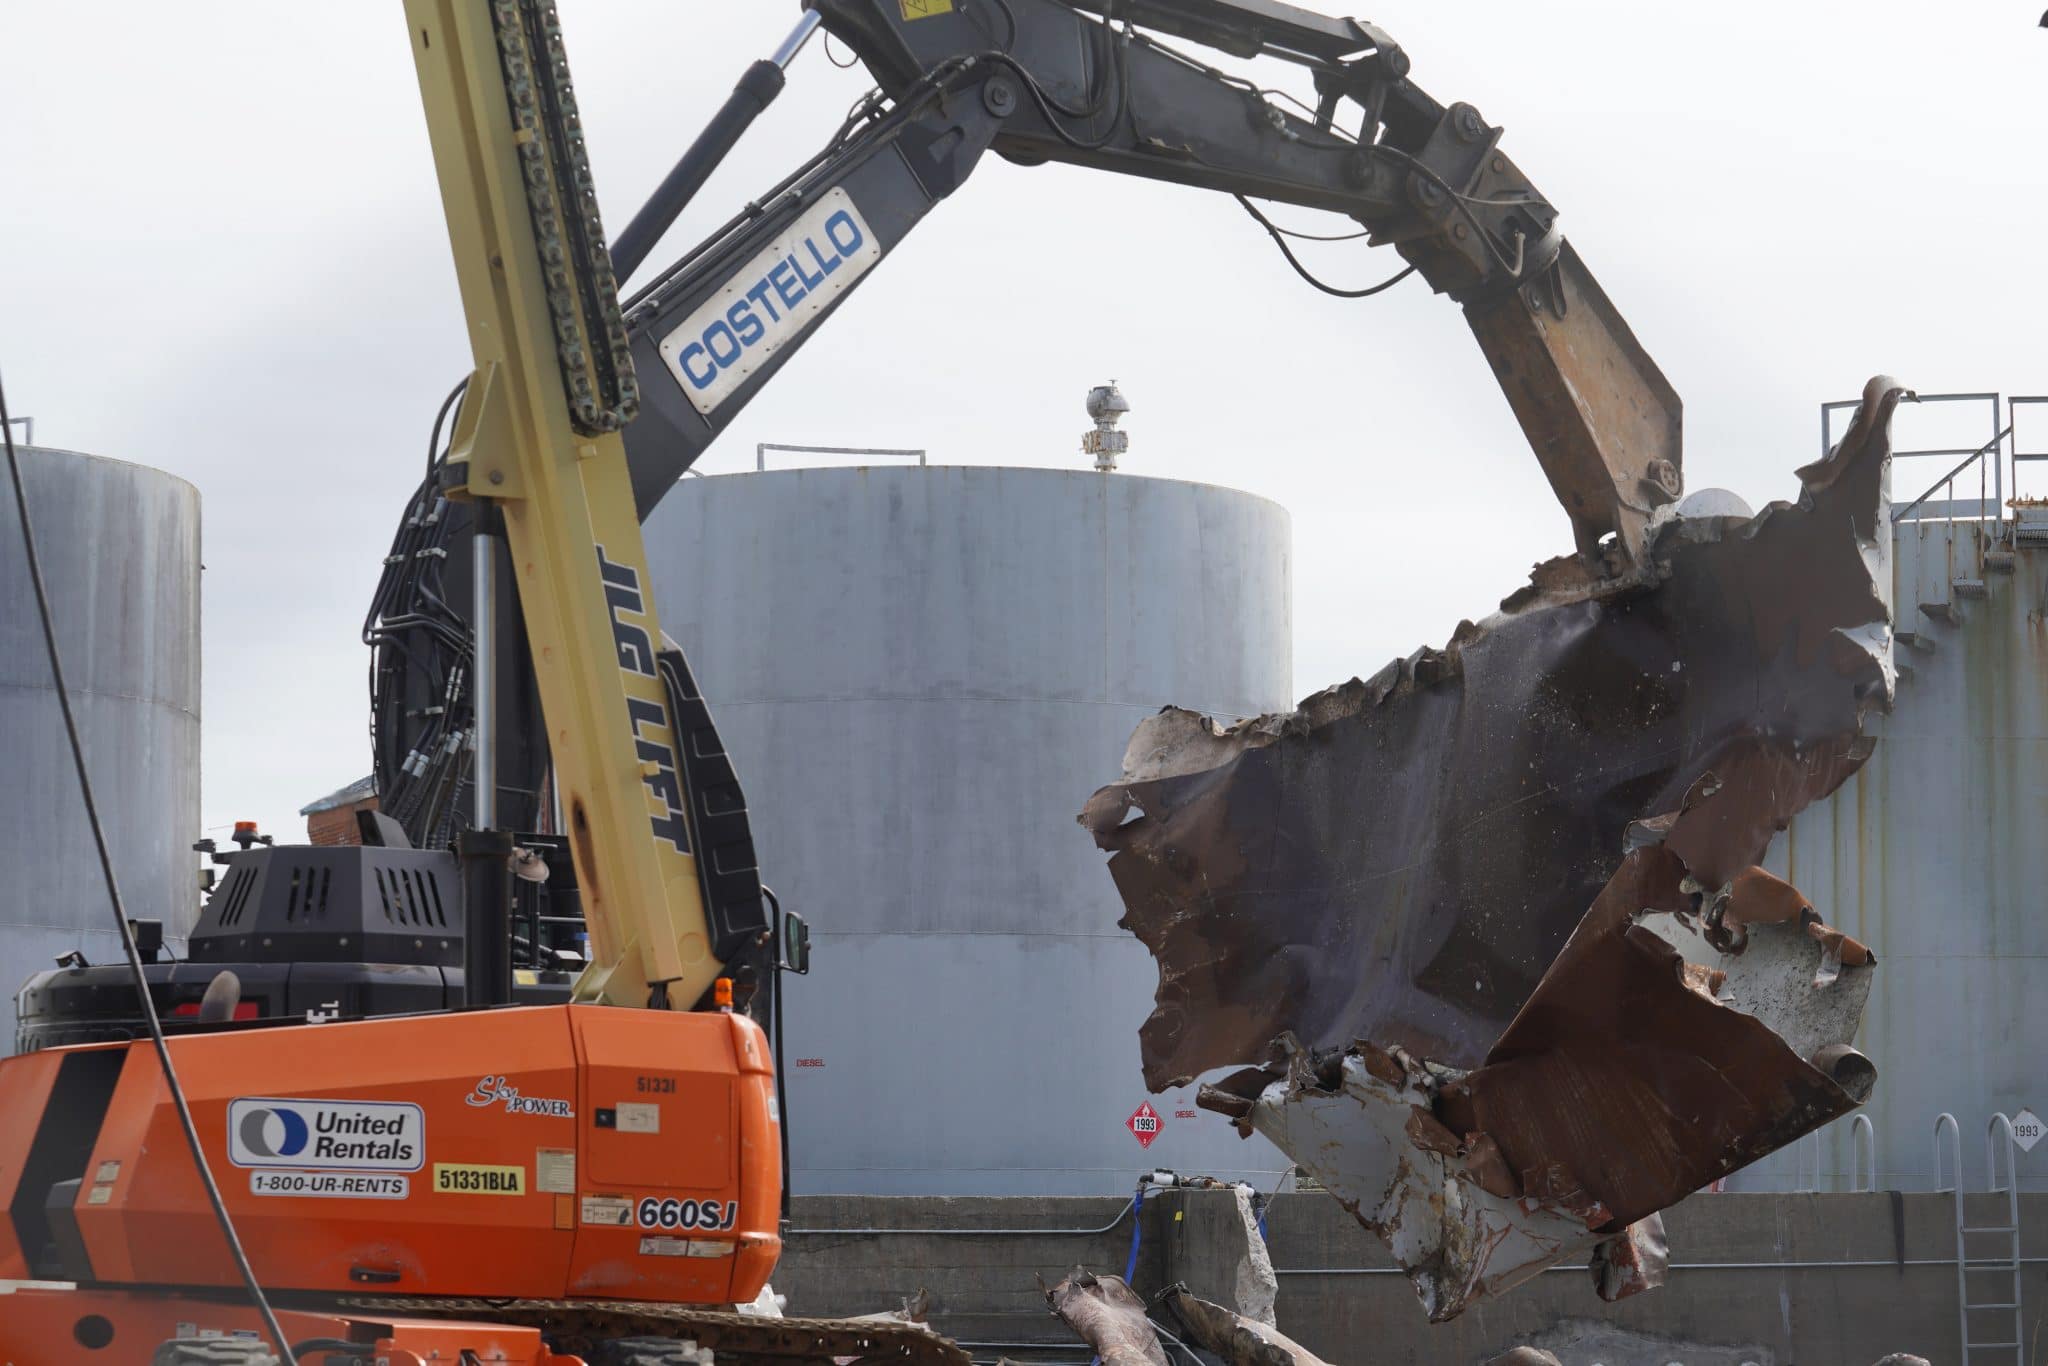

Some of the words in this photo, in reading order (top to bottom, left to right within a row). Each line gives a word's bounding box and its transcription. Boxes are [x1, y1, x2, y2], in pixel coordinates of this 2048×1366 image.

[679, 209, 863, 390] COSTELLO
[594, 543, 658, 678] JLG
[626, 697, 693, 856] LIFT
[796, 1058, 825, 1068] DIESEL
[465, 1075, 518, 1112] Sky
[512, 1096, 570, 1116] POWER
[315, 1111, 406, 1135] United
[1136, 1118, 1155, 1130] 1993
[1175, 1110, 1197, 1118] DIESEL
[2014, 1124, 2039, 1137] 1993
[314, 1136, 413, 1160] Rentals
[255, 1175, 403, 1194] 1-800-UR-RENTS
[440, 1169, 518, 1191] 51331BLA
[638, 1197, 738, 1232] 660SJ
